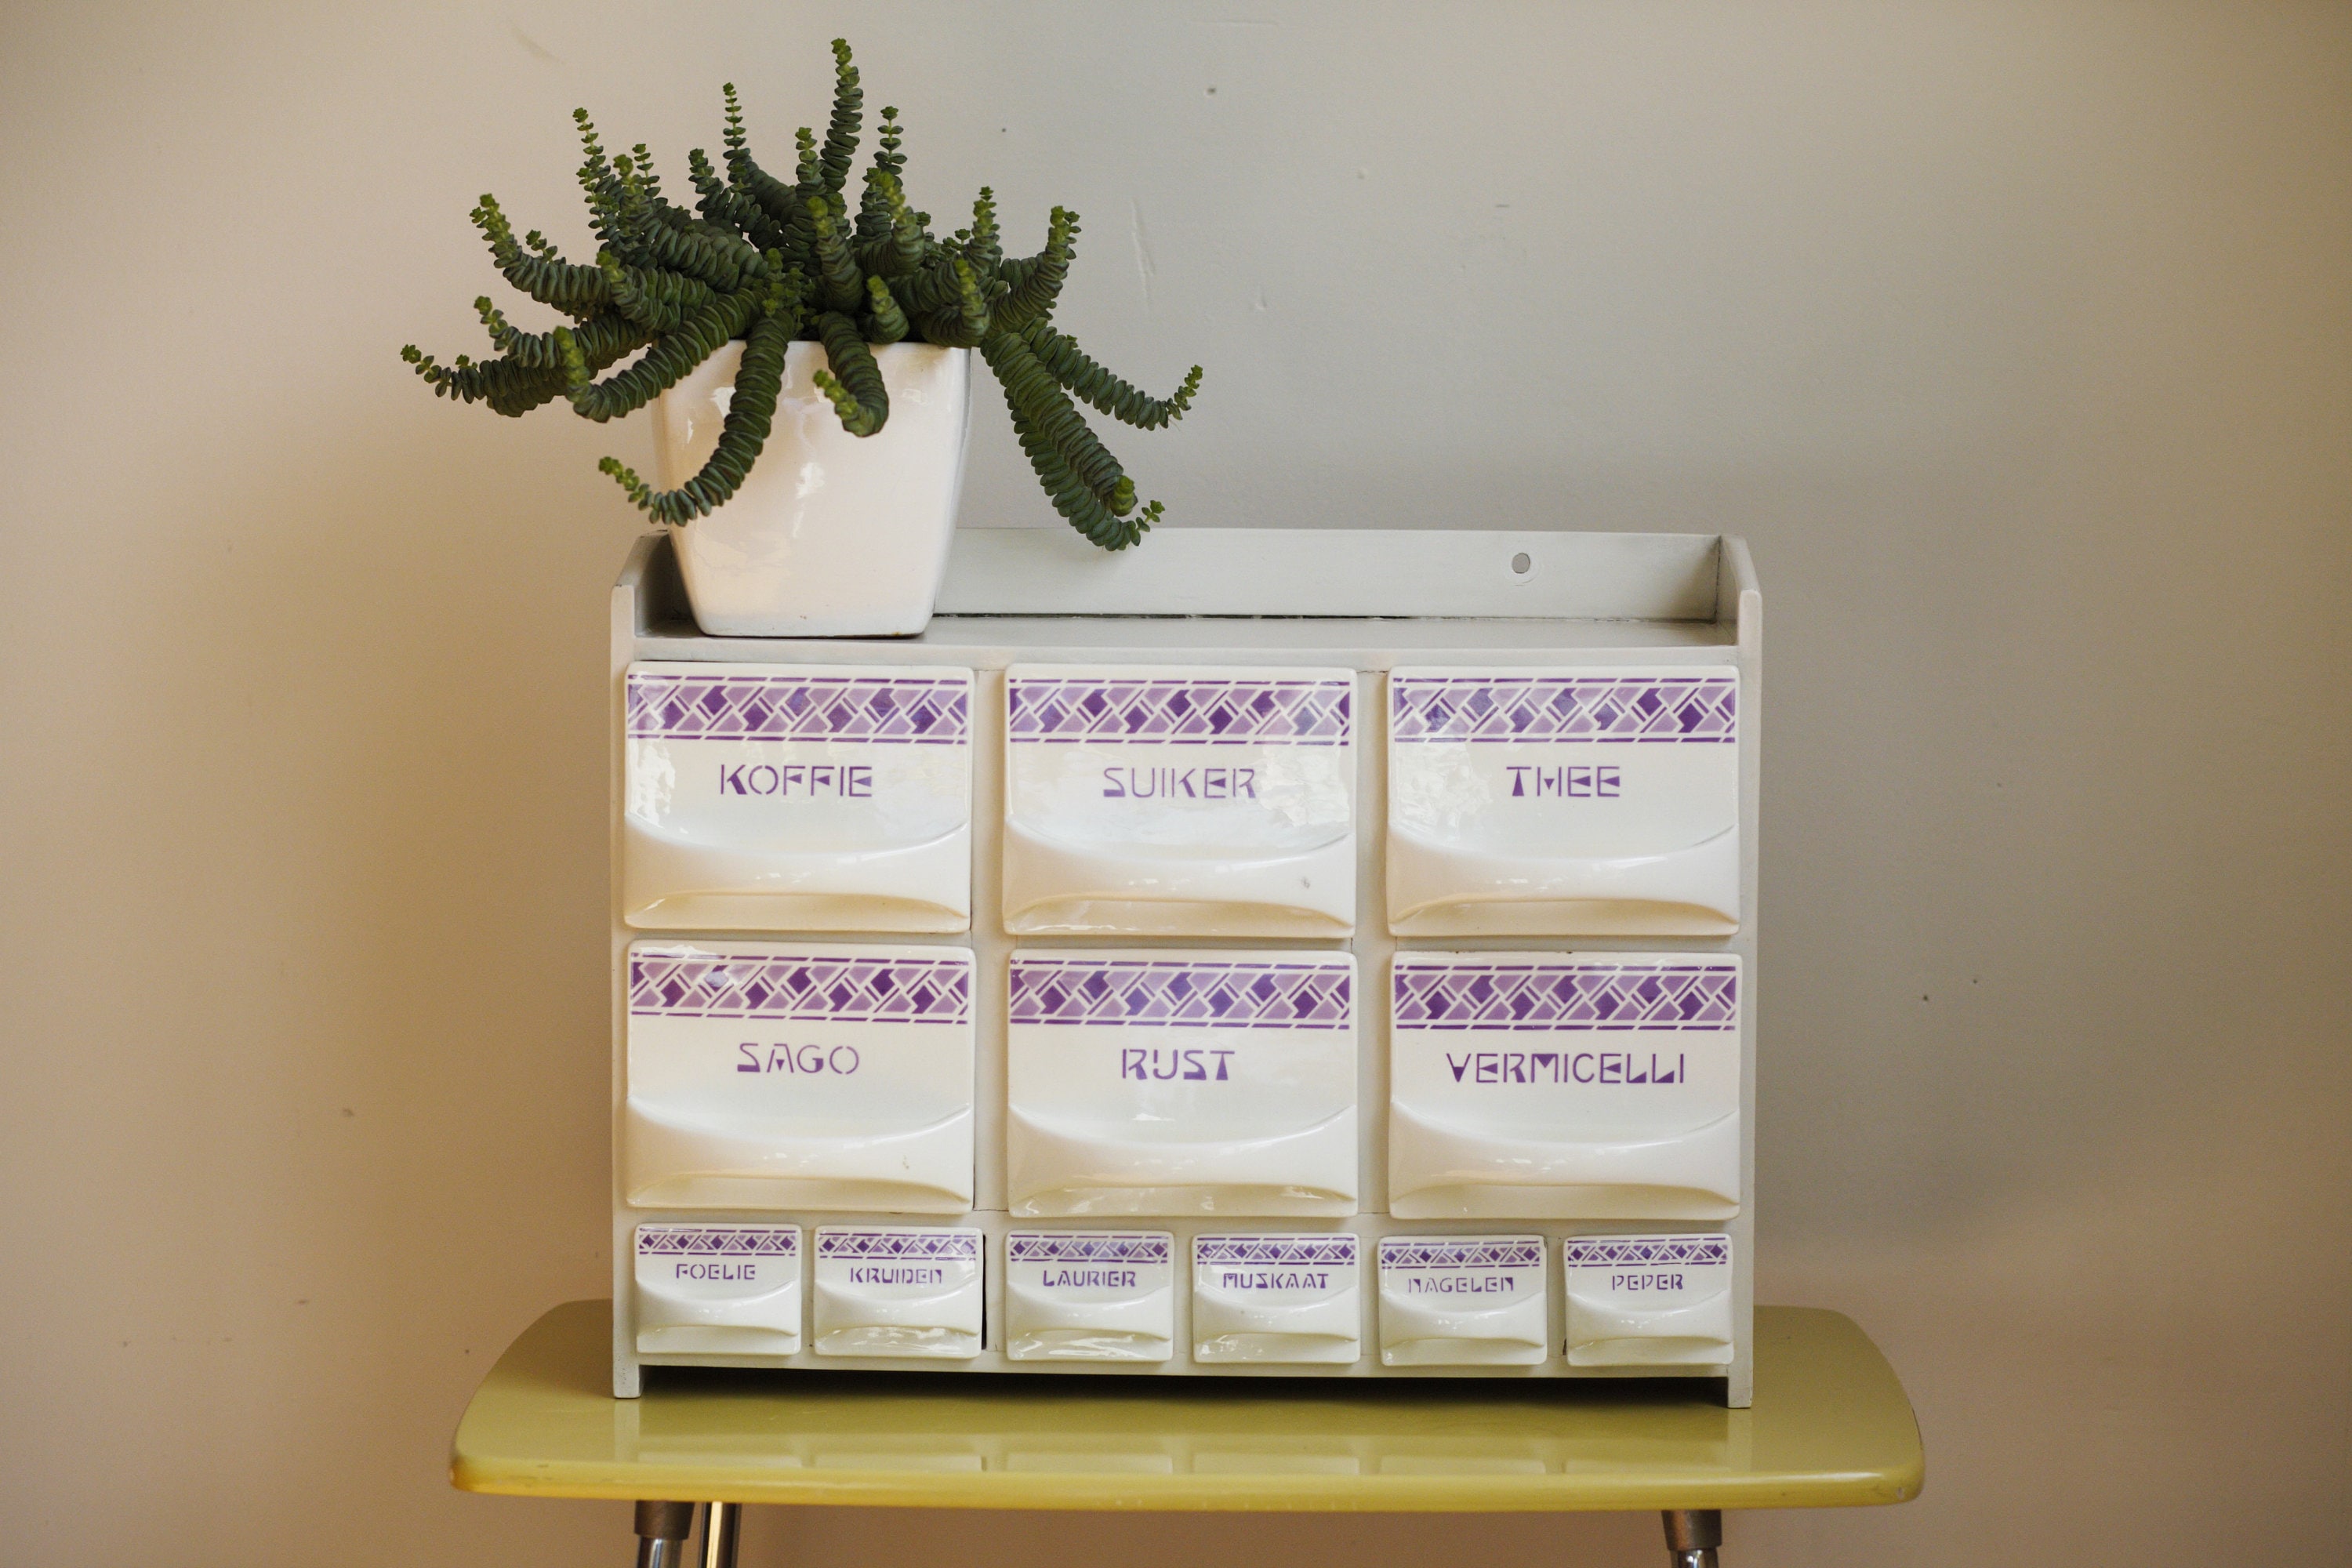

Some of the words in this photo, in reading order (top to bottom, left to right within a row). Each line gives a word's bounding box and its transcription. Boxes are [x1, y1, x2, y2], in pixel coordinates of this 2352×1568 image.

[720, 764, 872, 797] KOFFIE
[1103, 767, 1255, 800] SUIKER
[1506, 766, 1621, 797] THEE
[736, 1042, 859, 1075] SAGO
[1446, 1053, 1684, 1084] VERMICELLI
[675, 1263, 756, 1280] FOELIE
[850, 1267, 942, 1284] KRUIDEN
[1043, 1270, 1136, 1288] LAURIER
[1223, 1272, 1329, 1290] MUSKAAT
[1408, 1276, 1514, 1293] NAGELEN
[1612, 1274, 1684, 1291] PEPER
